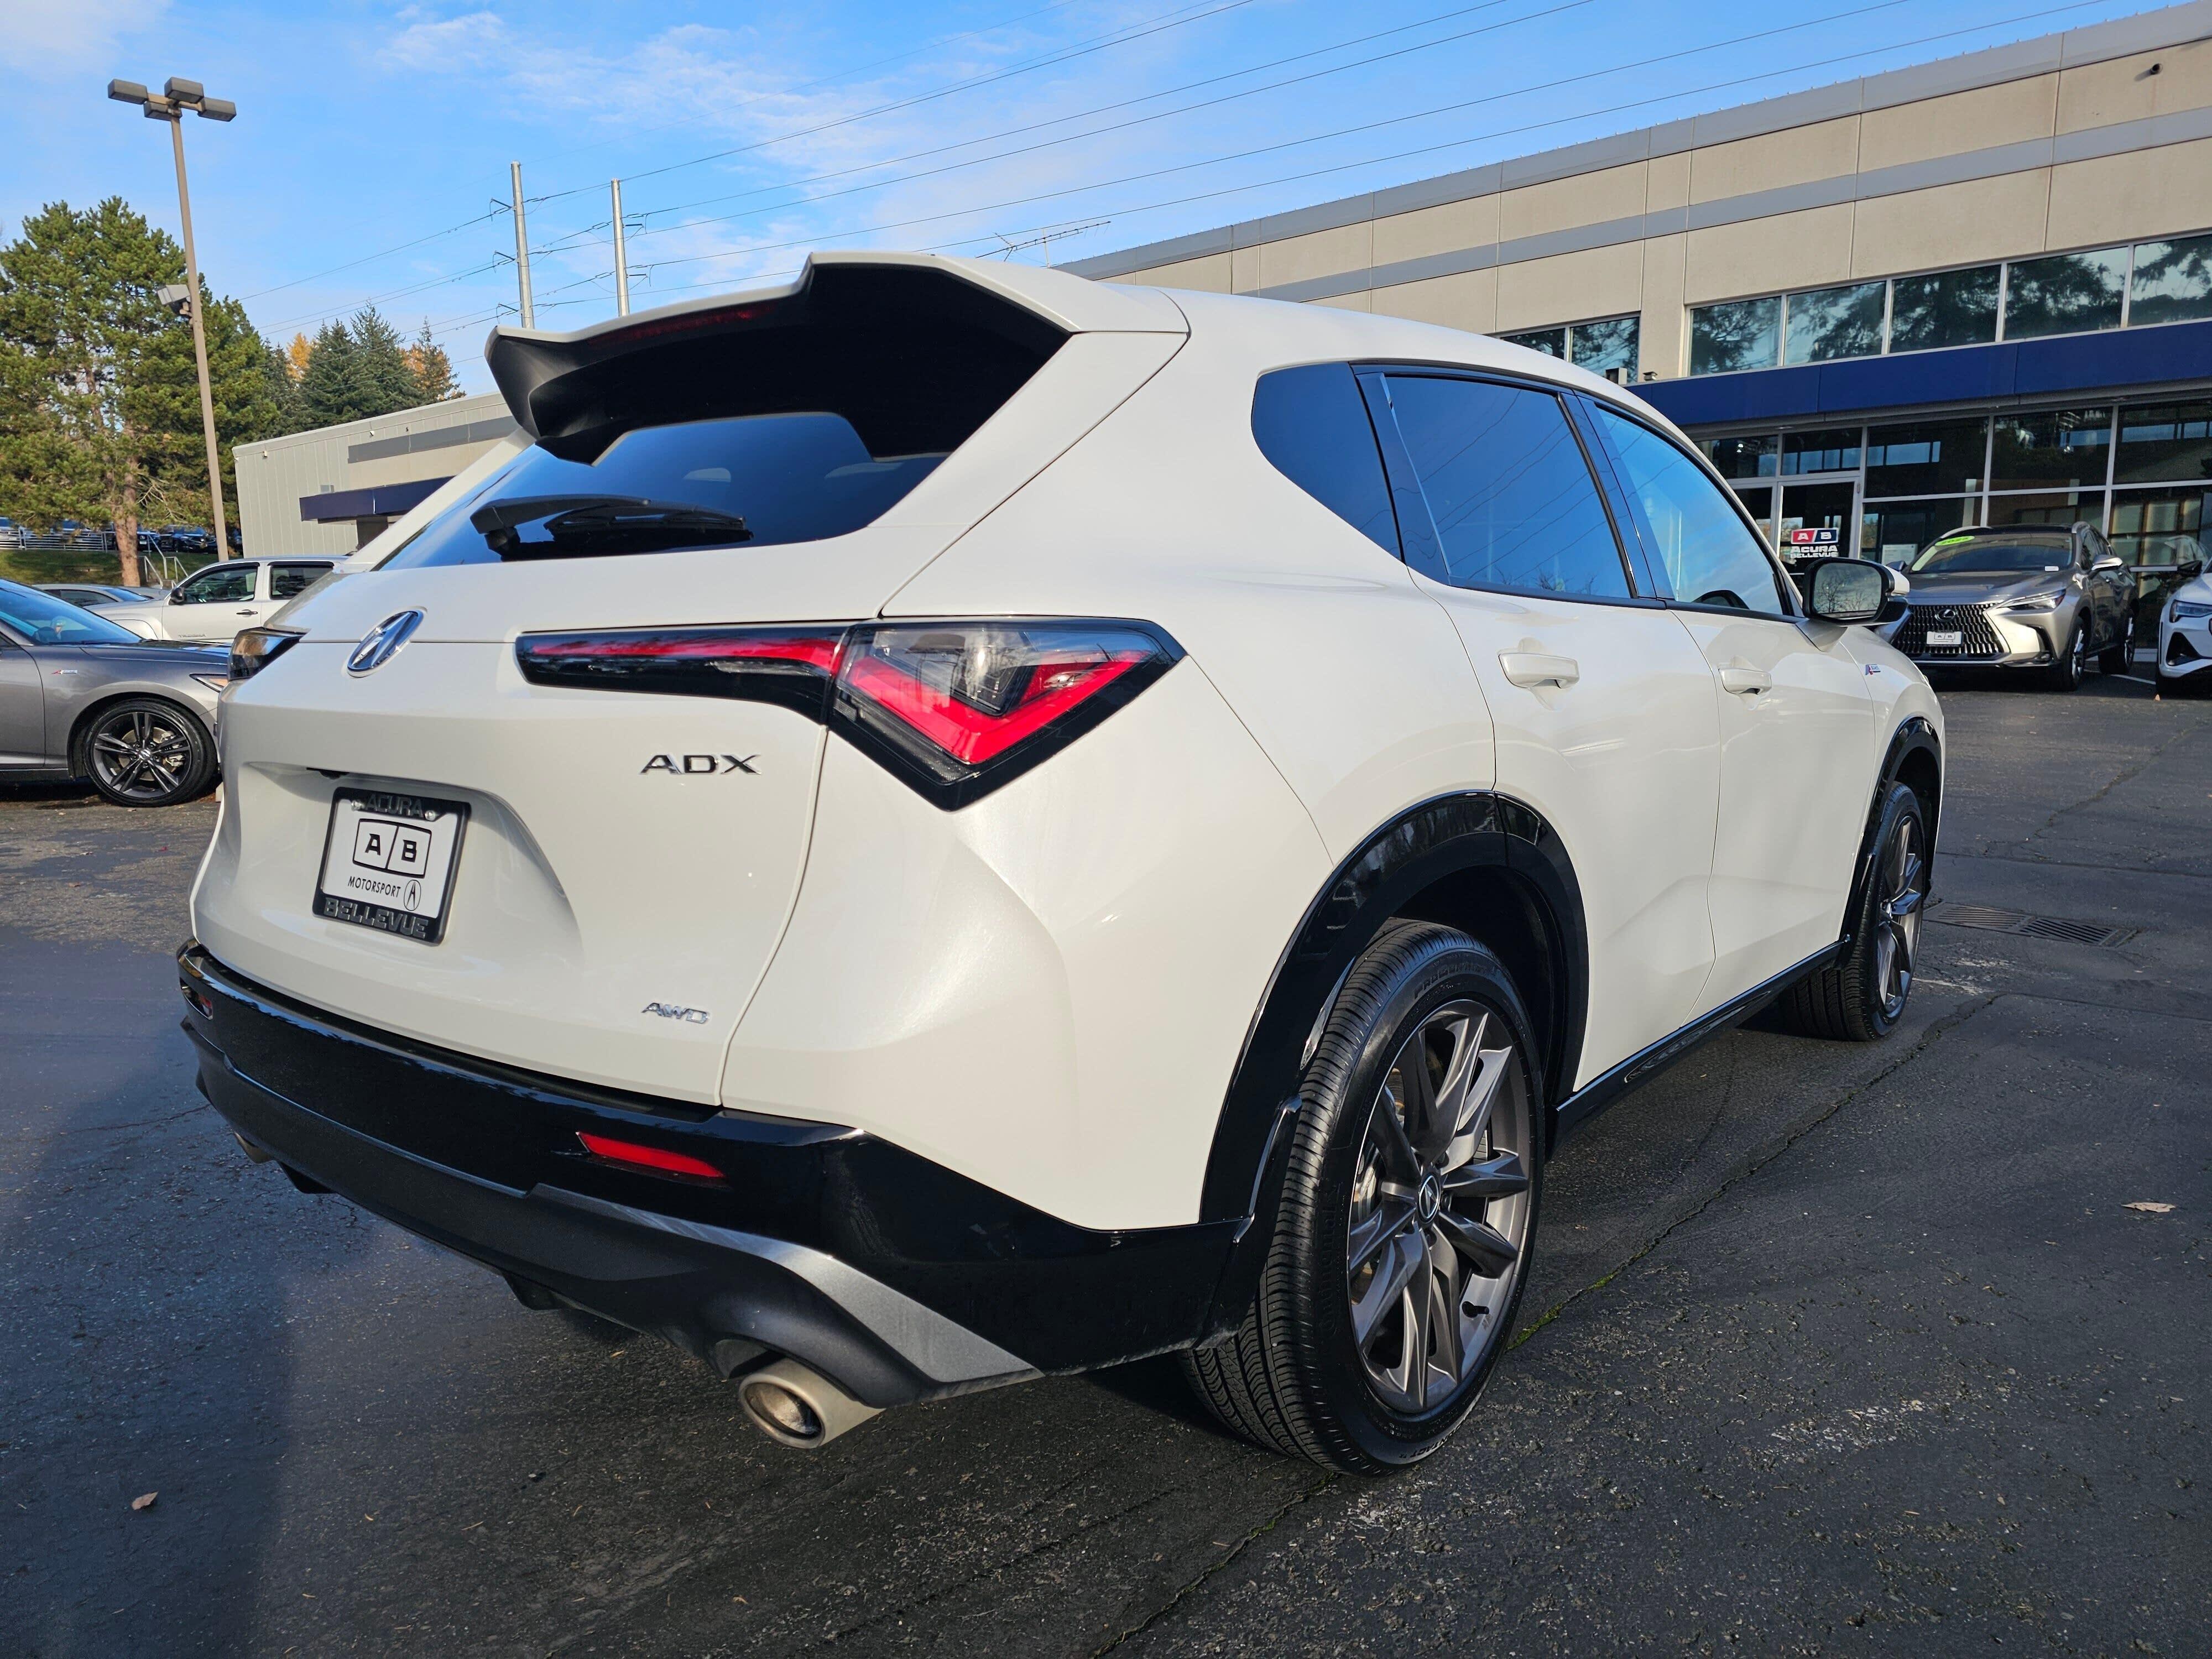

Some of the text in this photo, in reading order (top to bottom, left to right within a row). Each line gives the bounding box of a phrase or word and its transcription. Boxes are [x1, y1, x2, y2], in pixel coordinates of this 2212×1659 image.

[1791, 545, 1838, 554] ACURA
[639, 754, 761, 775] ADX
[366, 793, 424, 818] ACURA
[364, 833, 417, 863] A B
[347, 875, 401, 898] MOTORSPORT
[324, 897, 429, 940] BELLEVUE
[641, 1002, 709, 1024] AWD
